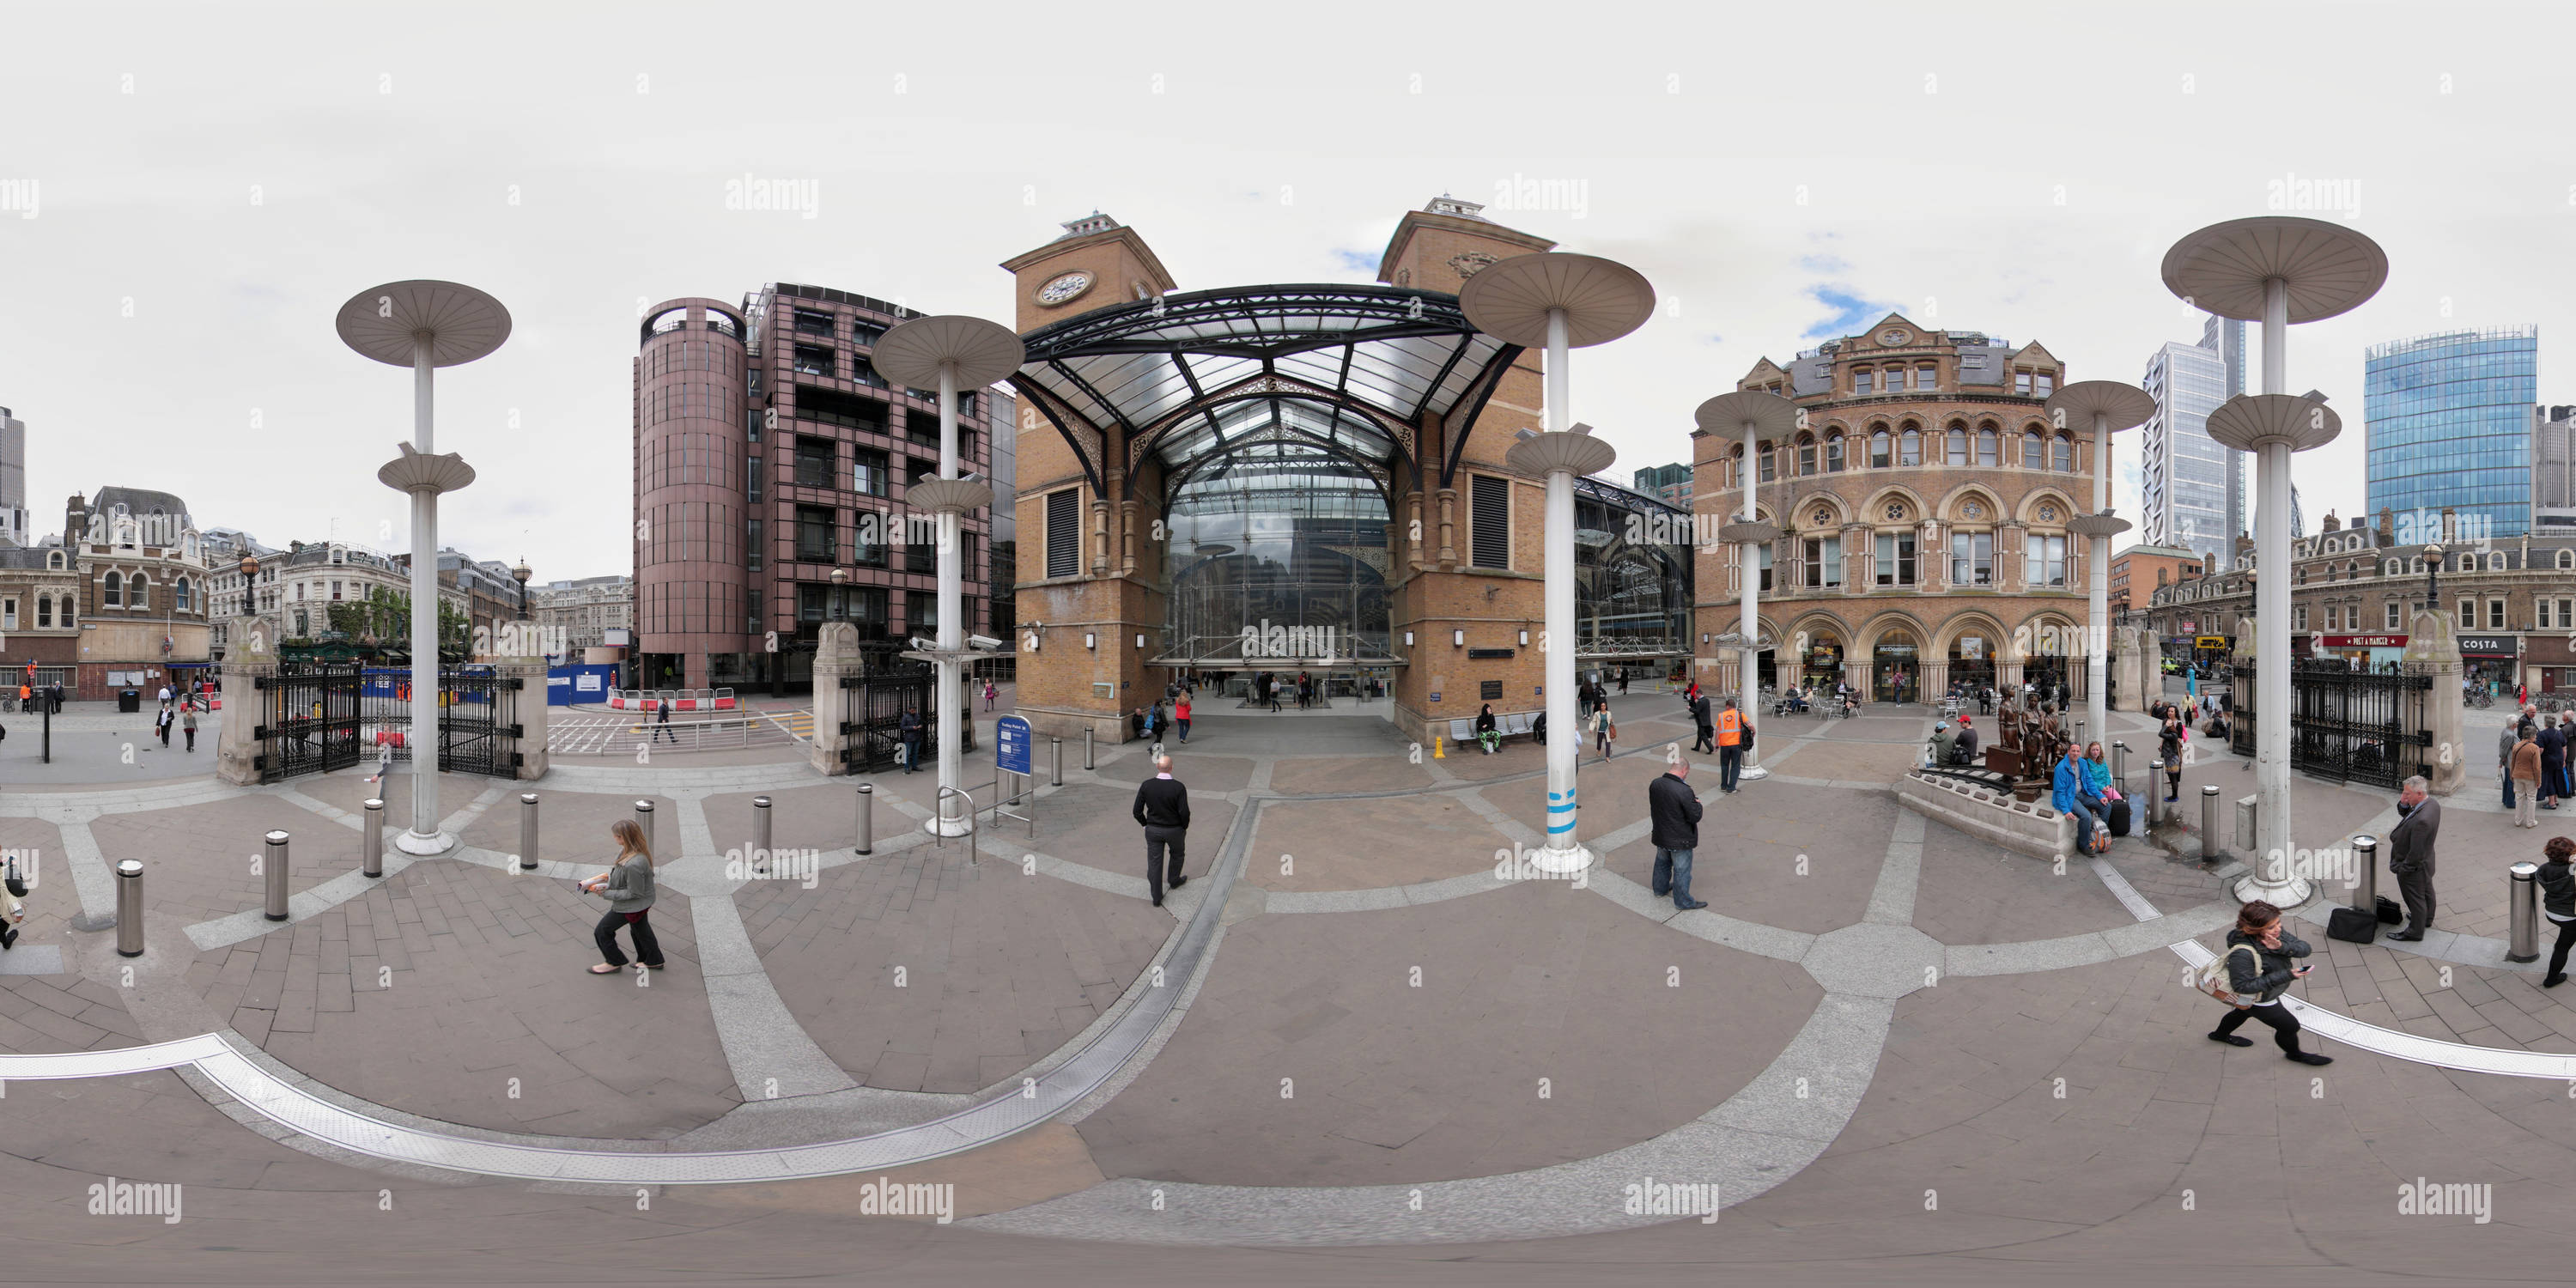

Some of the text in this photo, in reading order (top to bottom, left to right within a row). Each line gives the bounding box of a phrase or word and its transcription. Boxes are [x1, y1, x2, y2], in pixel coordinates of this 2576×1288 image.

[2353, 637, 2364, 646] PRET
[2365, 637, 2369, 646] A
[2463, 640, 2498, 650] COSTA
